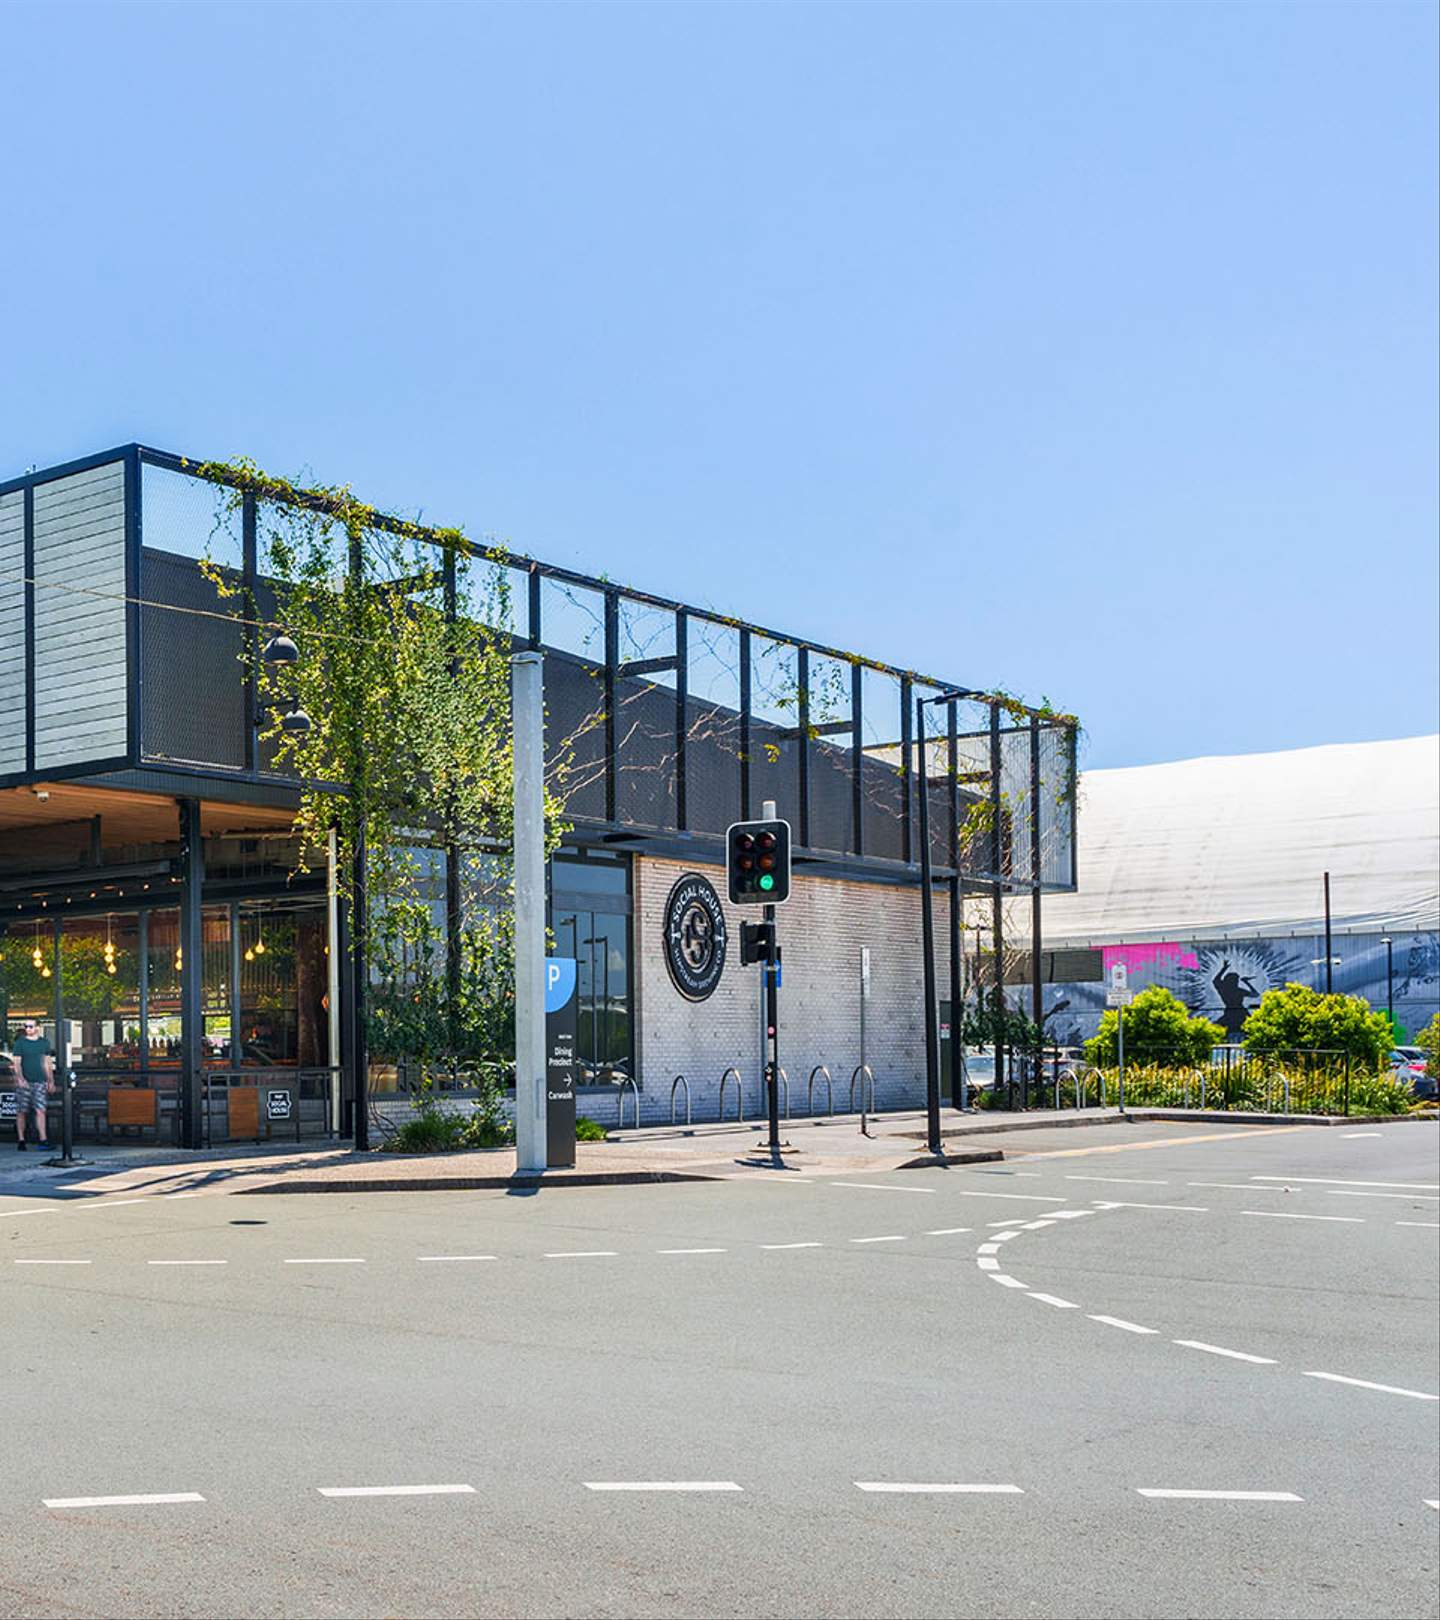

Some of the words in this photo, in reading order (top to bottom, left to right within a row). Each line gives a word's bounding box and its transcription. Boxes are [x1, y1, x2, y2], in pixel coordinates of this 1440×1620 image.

[672, 884, 698, 923] SOCIAL
[698, 885, 723, 925] HOUSE
[548, 964, 560, 991] P
[554, 1046, 573, 1057] Dining
[548, 1057, 573, 1067] Precinct
